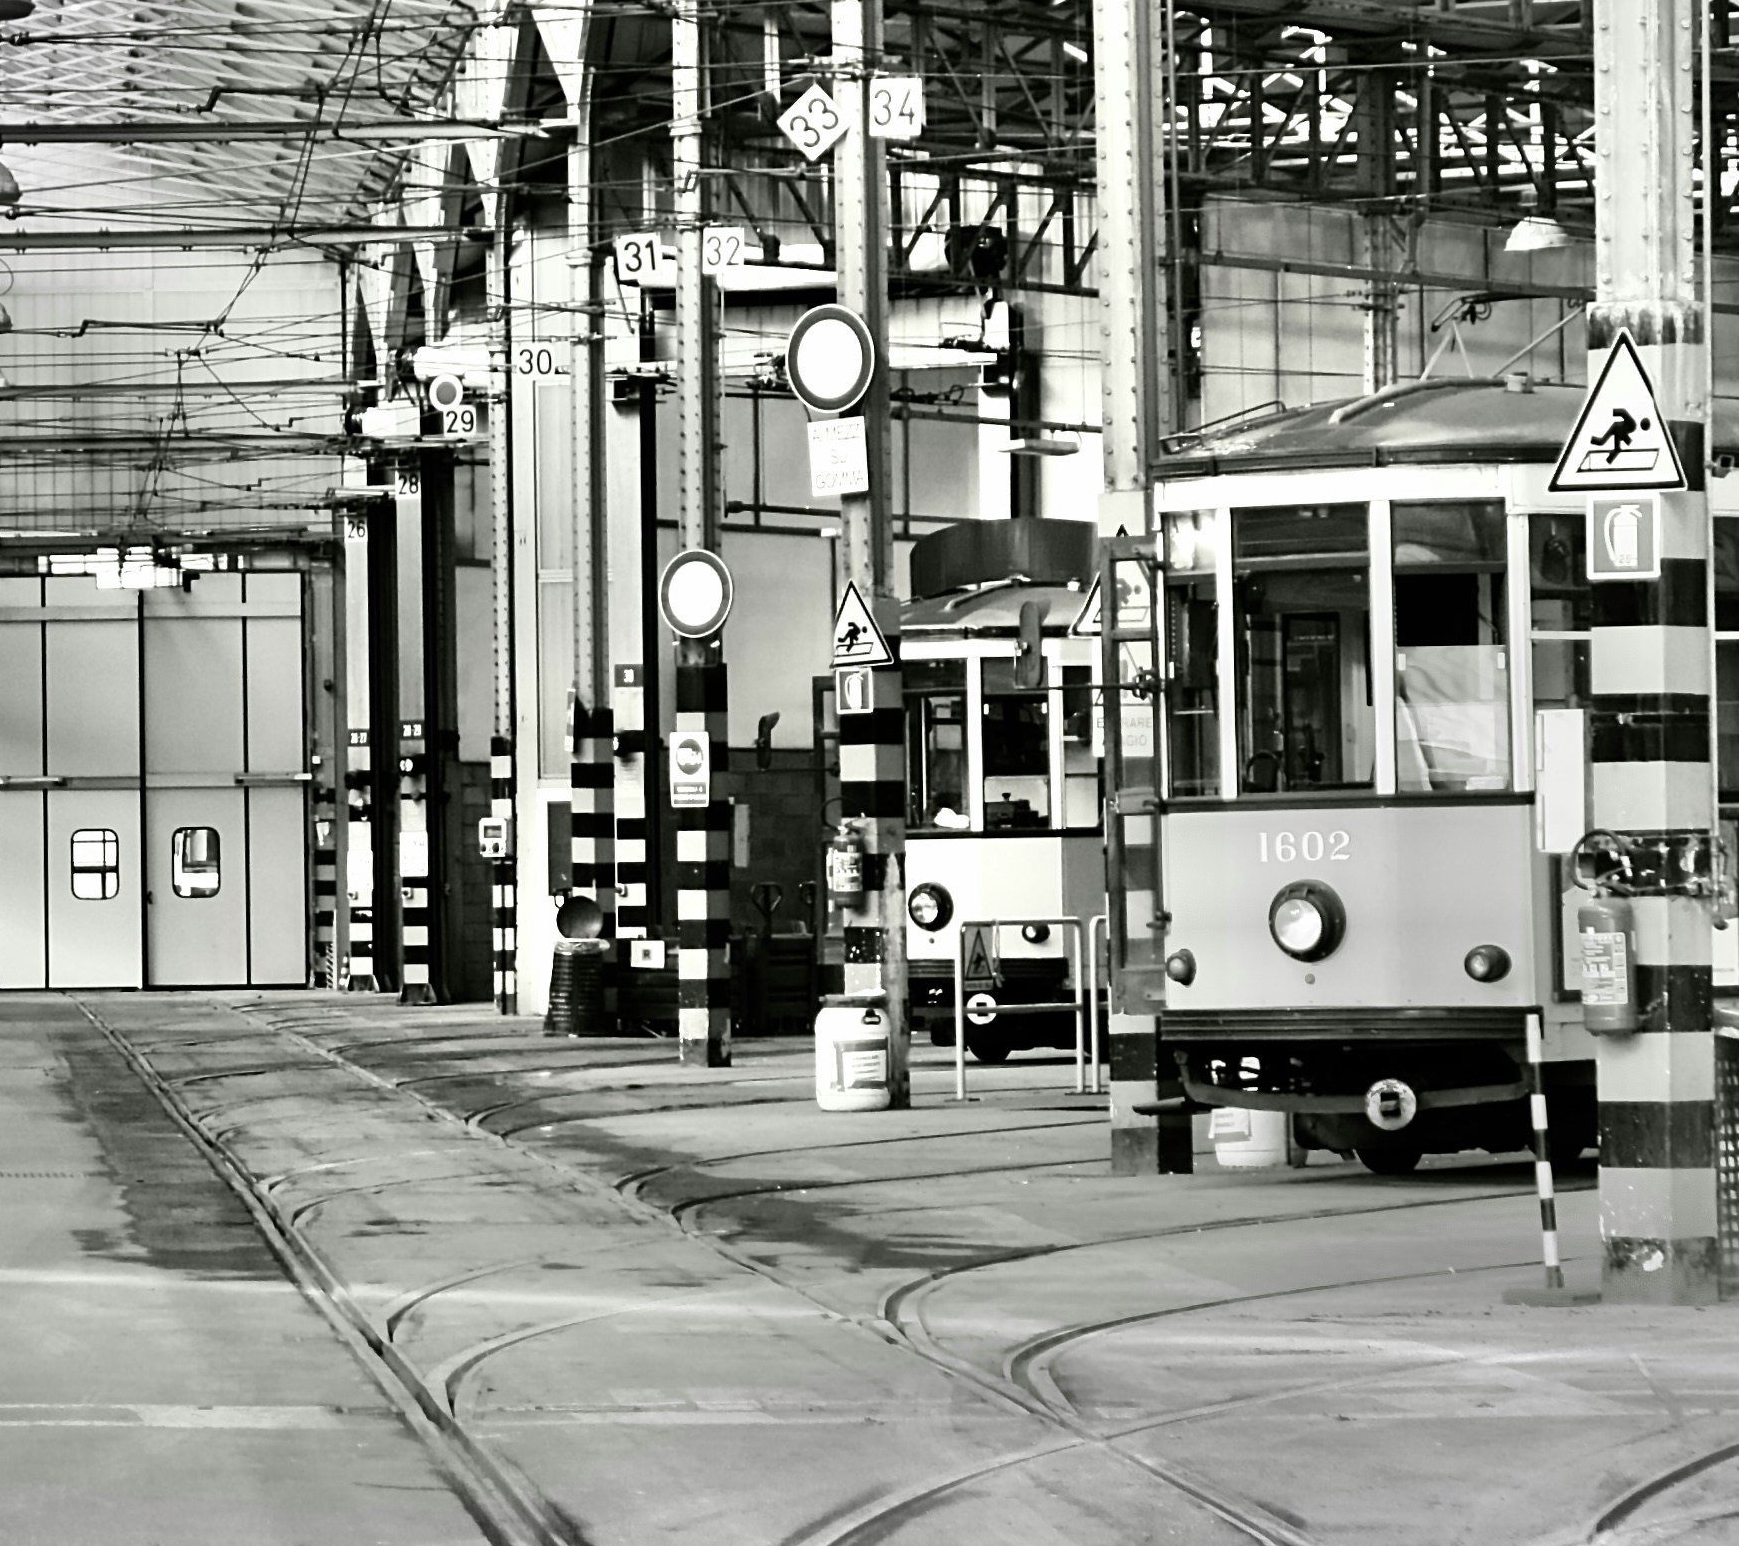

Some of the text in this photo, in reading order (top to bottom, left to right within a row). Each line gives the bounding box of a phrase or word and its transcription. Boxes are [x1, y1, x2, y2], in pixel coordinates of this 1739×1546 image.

[789, 97, 839, 148] 33
[873, 89, 915, 127] 34
[623, 239, 656, 273] 31
[706, 235, 740, 267] 32
[518, 348, 552, 375] 30
[446, 409, 475, 434] 29
[398, 474, 420, 495] 28
[347, 519, 367, 539] 26
[1259, 830, 1351, 863] 1602
